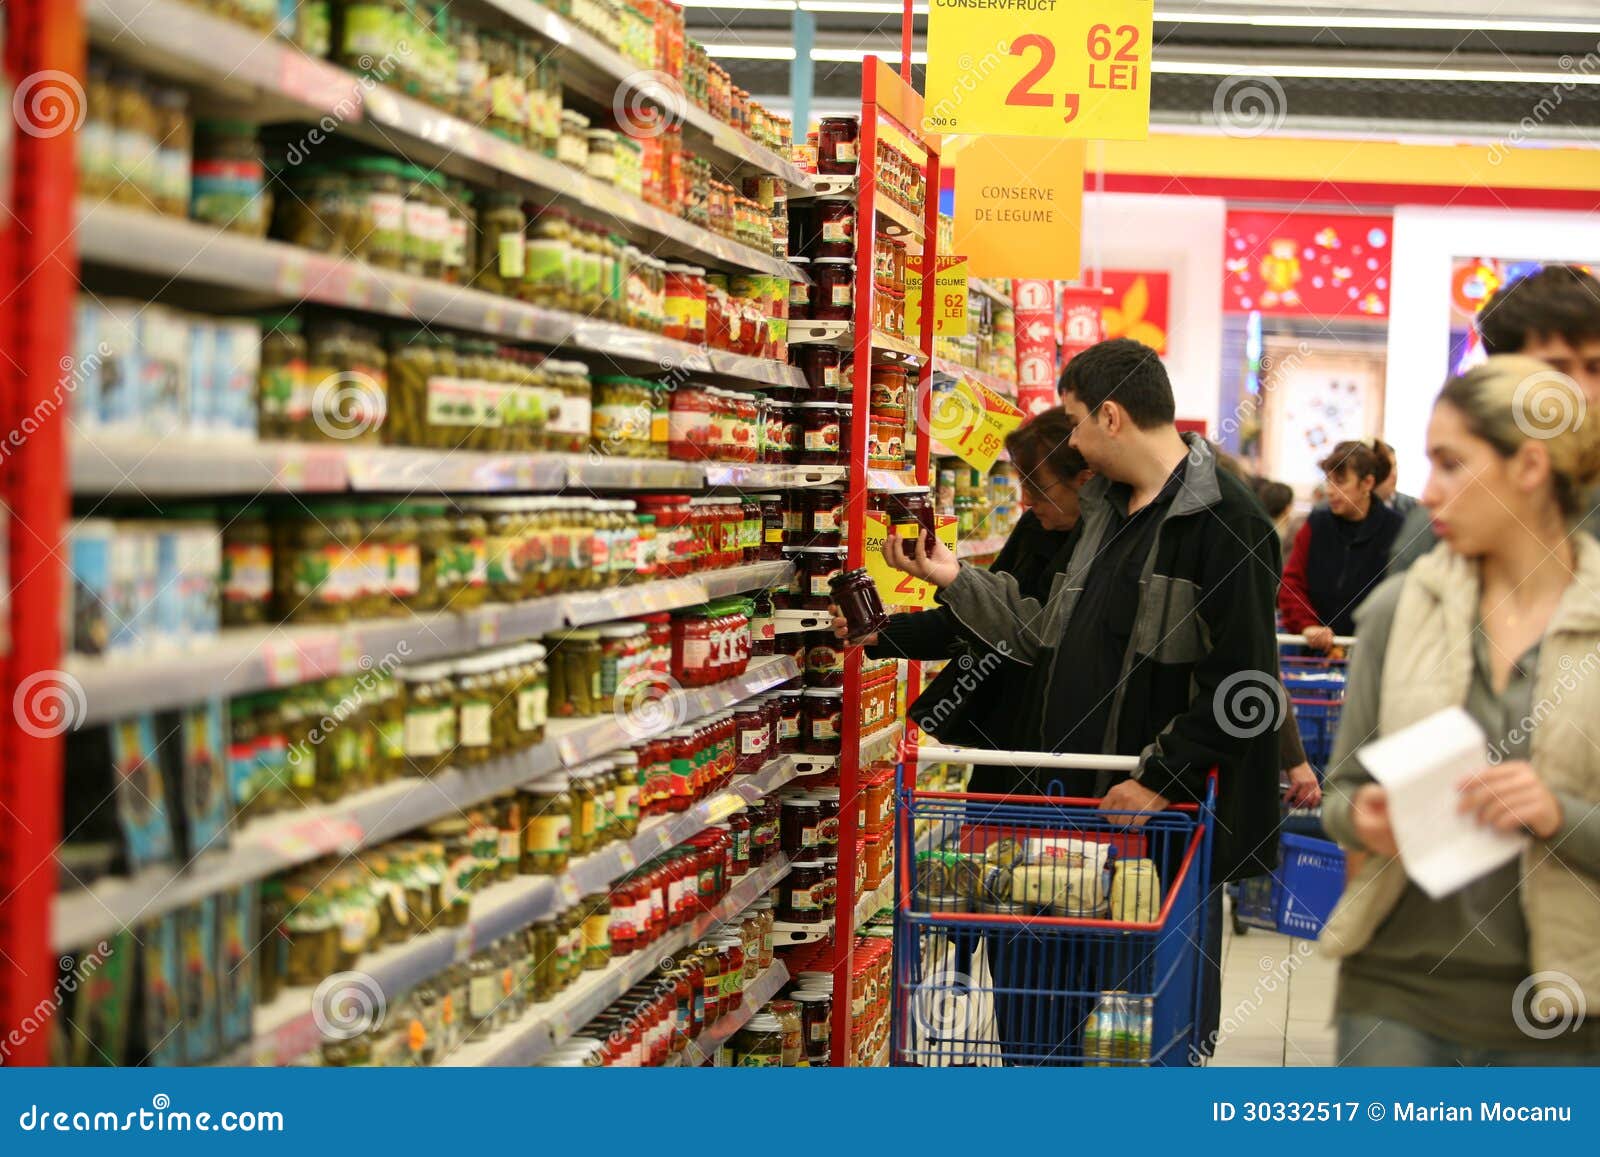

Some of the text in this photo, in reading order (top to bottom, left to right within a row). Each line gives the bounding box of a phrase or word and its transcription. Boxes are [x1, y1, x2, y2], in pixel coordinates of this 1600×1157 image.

[1087, 23, 1139, 61] 62
[1088, 63, 1138, 90] LEI
[950, 118, 957, 127] G
[982, 186, 1054, 201] CONSERVE
[975, 208, 1053, 223] DE LEGUME
[936, 278, 966, 287] EGUME
[944, 294, 964, 308] 62
[944, 308, 963, 318] LEI
[983, 433, 1001, 450] 65
[977, 443, 995, 458] LEI
